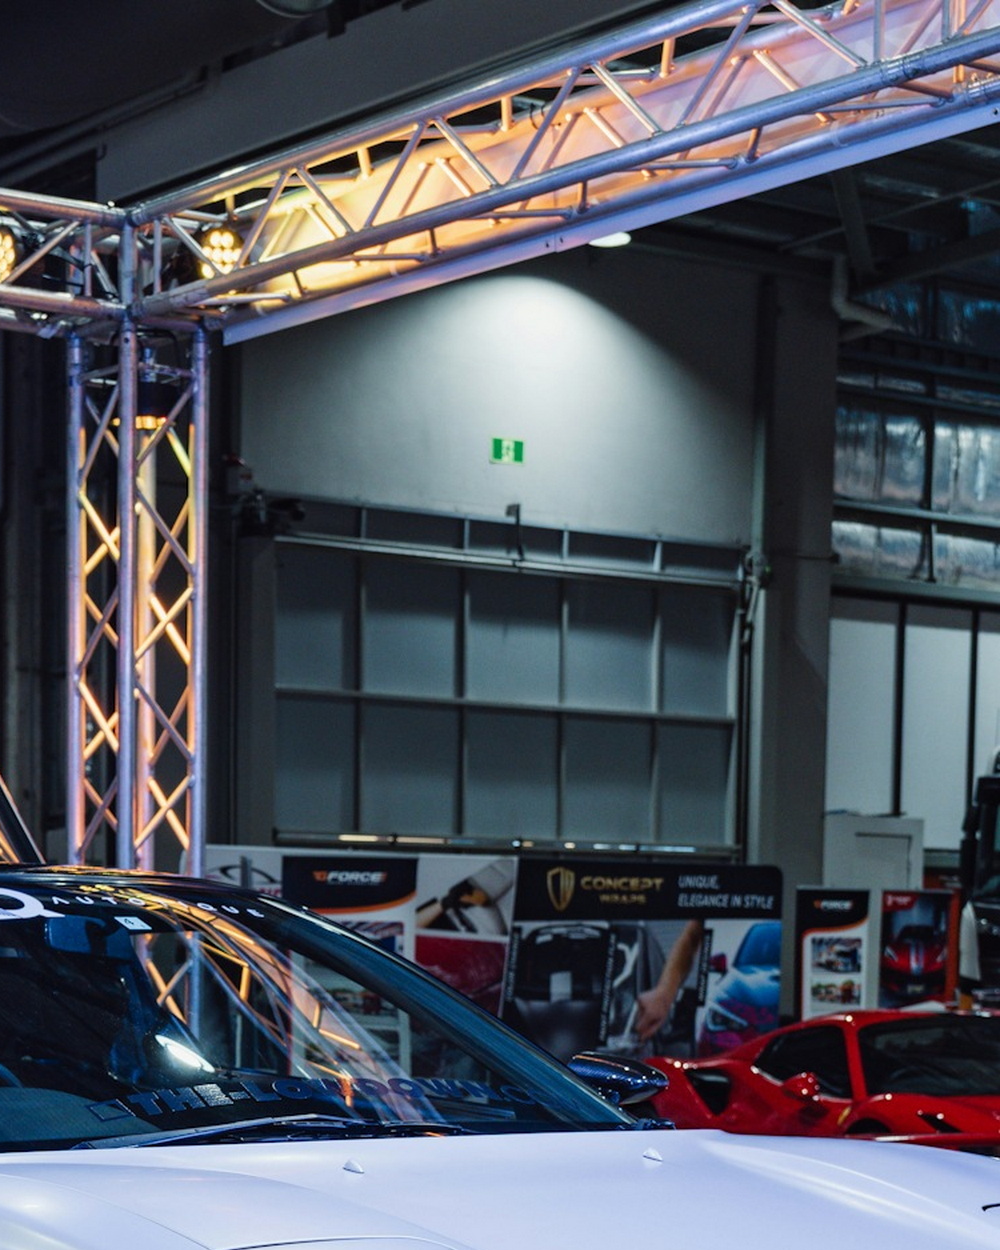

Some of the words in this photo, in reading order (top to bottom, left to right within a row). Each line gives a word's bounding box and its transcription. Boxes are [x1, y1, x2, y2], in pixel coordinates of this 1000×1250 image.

[580, 876, 664, 891] CONCEPT
[51, 895, 265, 919] AUTOTIQUE
[677, 893, 729, 908] ELEGANCE
[730, 894, 742, 908] IN
[743, 895, 775, 910] STYLE
[127, 1078, 590, 1115] THE-LOWDOWN.CO
